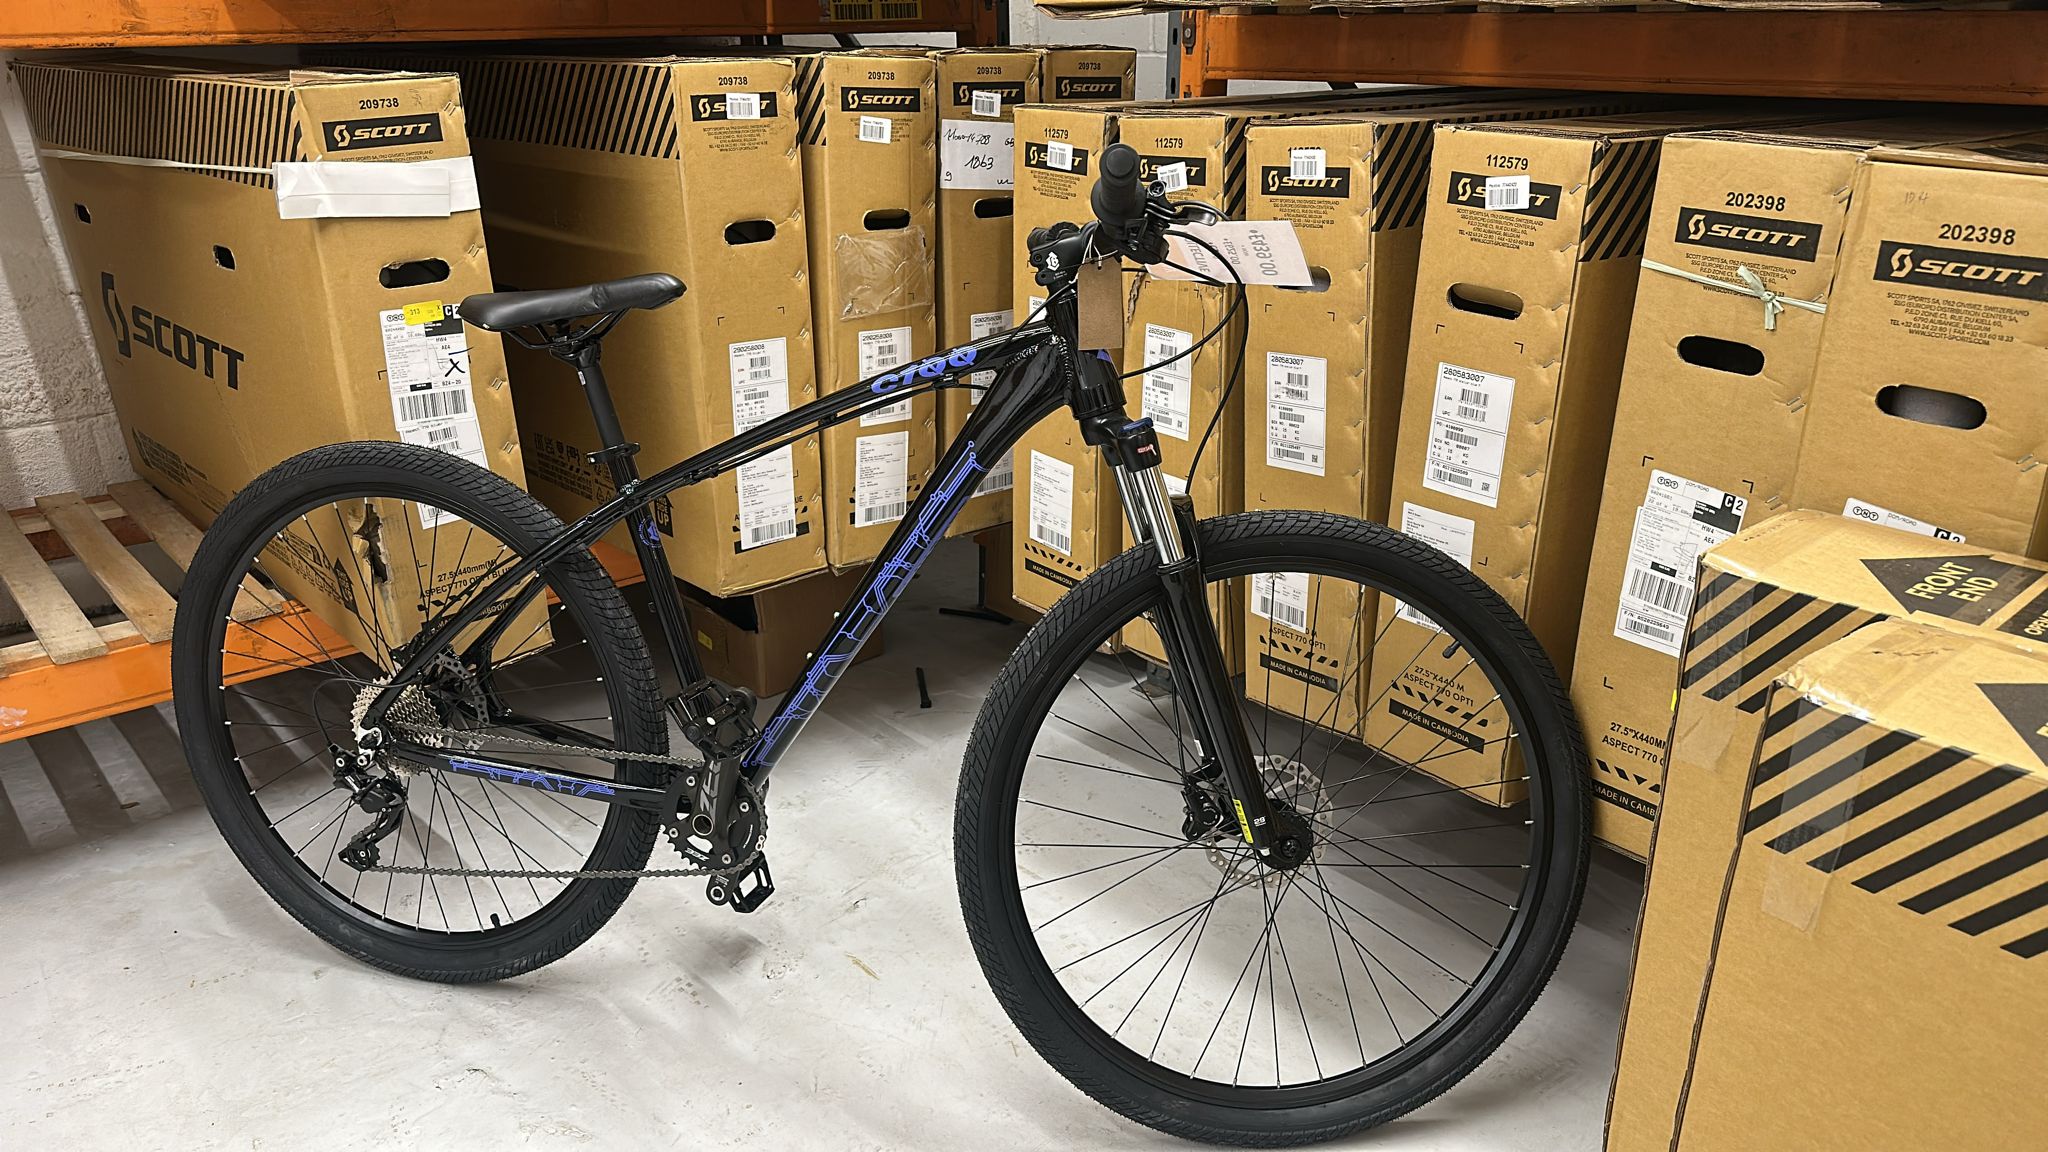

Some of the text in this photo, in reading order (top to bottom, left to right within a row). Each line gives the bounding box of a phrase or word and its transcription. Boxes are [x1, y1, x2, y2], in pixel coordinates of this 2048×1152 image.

[976, 66, 1002, 74] 209738
[1078, 62, 1100, 70] 209738
[718, 76, 748, 86] 209738
[868, 72, 895, 80] 209738
[1072, 83, 1116, 92] SCOTT
[359, 98, 400, 110] 209738
[860, 95, 914, 105] SCOTT
[353, 122, 432, 140] SCOTT
[1044, 128, 1068, 139] 112579
[1155, 138, 1183, 148] 112579
[1486, 154, 1528, 170] 112579
[1725, 192, 1786, 212] 202398
[1707, 224, 1806, 247] SCOTT
[1938, 224, 2016, 246] 202398
[1761, 265, 1797, 274] SWITZERLAND
[1914, 259, 2043, 285] SCOTT
[1907, 295, 1930, 303] SPORTS
[1984, 305, 2030, 316] SWITZERLAND
[1937, 305, 1980, 317] DISTRIBUTION
[1982, 312, 2007, 321] CENTER
[1962, 323, 1990, 332] BELGIUM
[132, 305, 244, 390] SCOTT
[1852, 506, 1879, 521] TNT
[1032, 565, 1044, 574] MADE
[1905, 562, 1973, 600] FRONT
[1948, 577, 1999, 602] END
[1295, 634, 1307, 644] 770
[1270, 660, 1286, 672] MADE
[1404, 672, 1434, 690] ASPECT
[1401, 709, 1421, 722] MADE
[1431, 722, 1470, 743] CAMBODIA
[1602, 735, 1640, 756] ASPECT
[1642, 750, 1658, 764] 770
[1619, 796, 1629, 805] IN
[1630, 800, 1657, 816] CAMB
